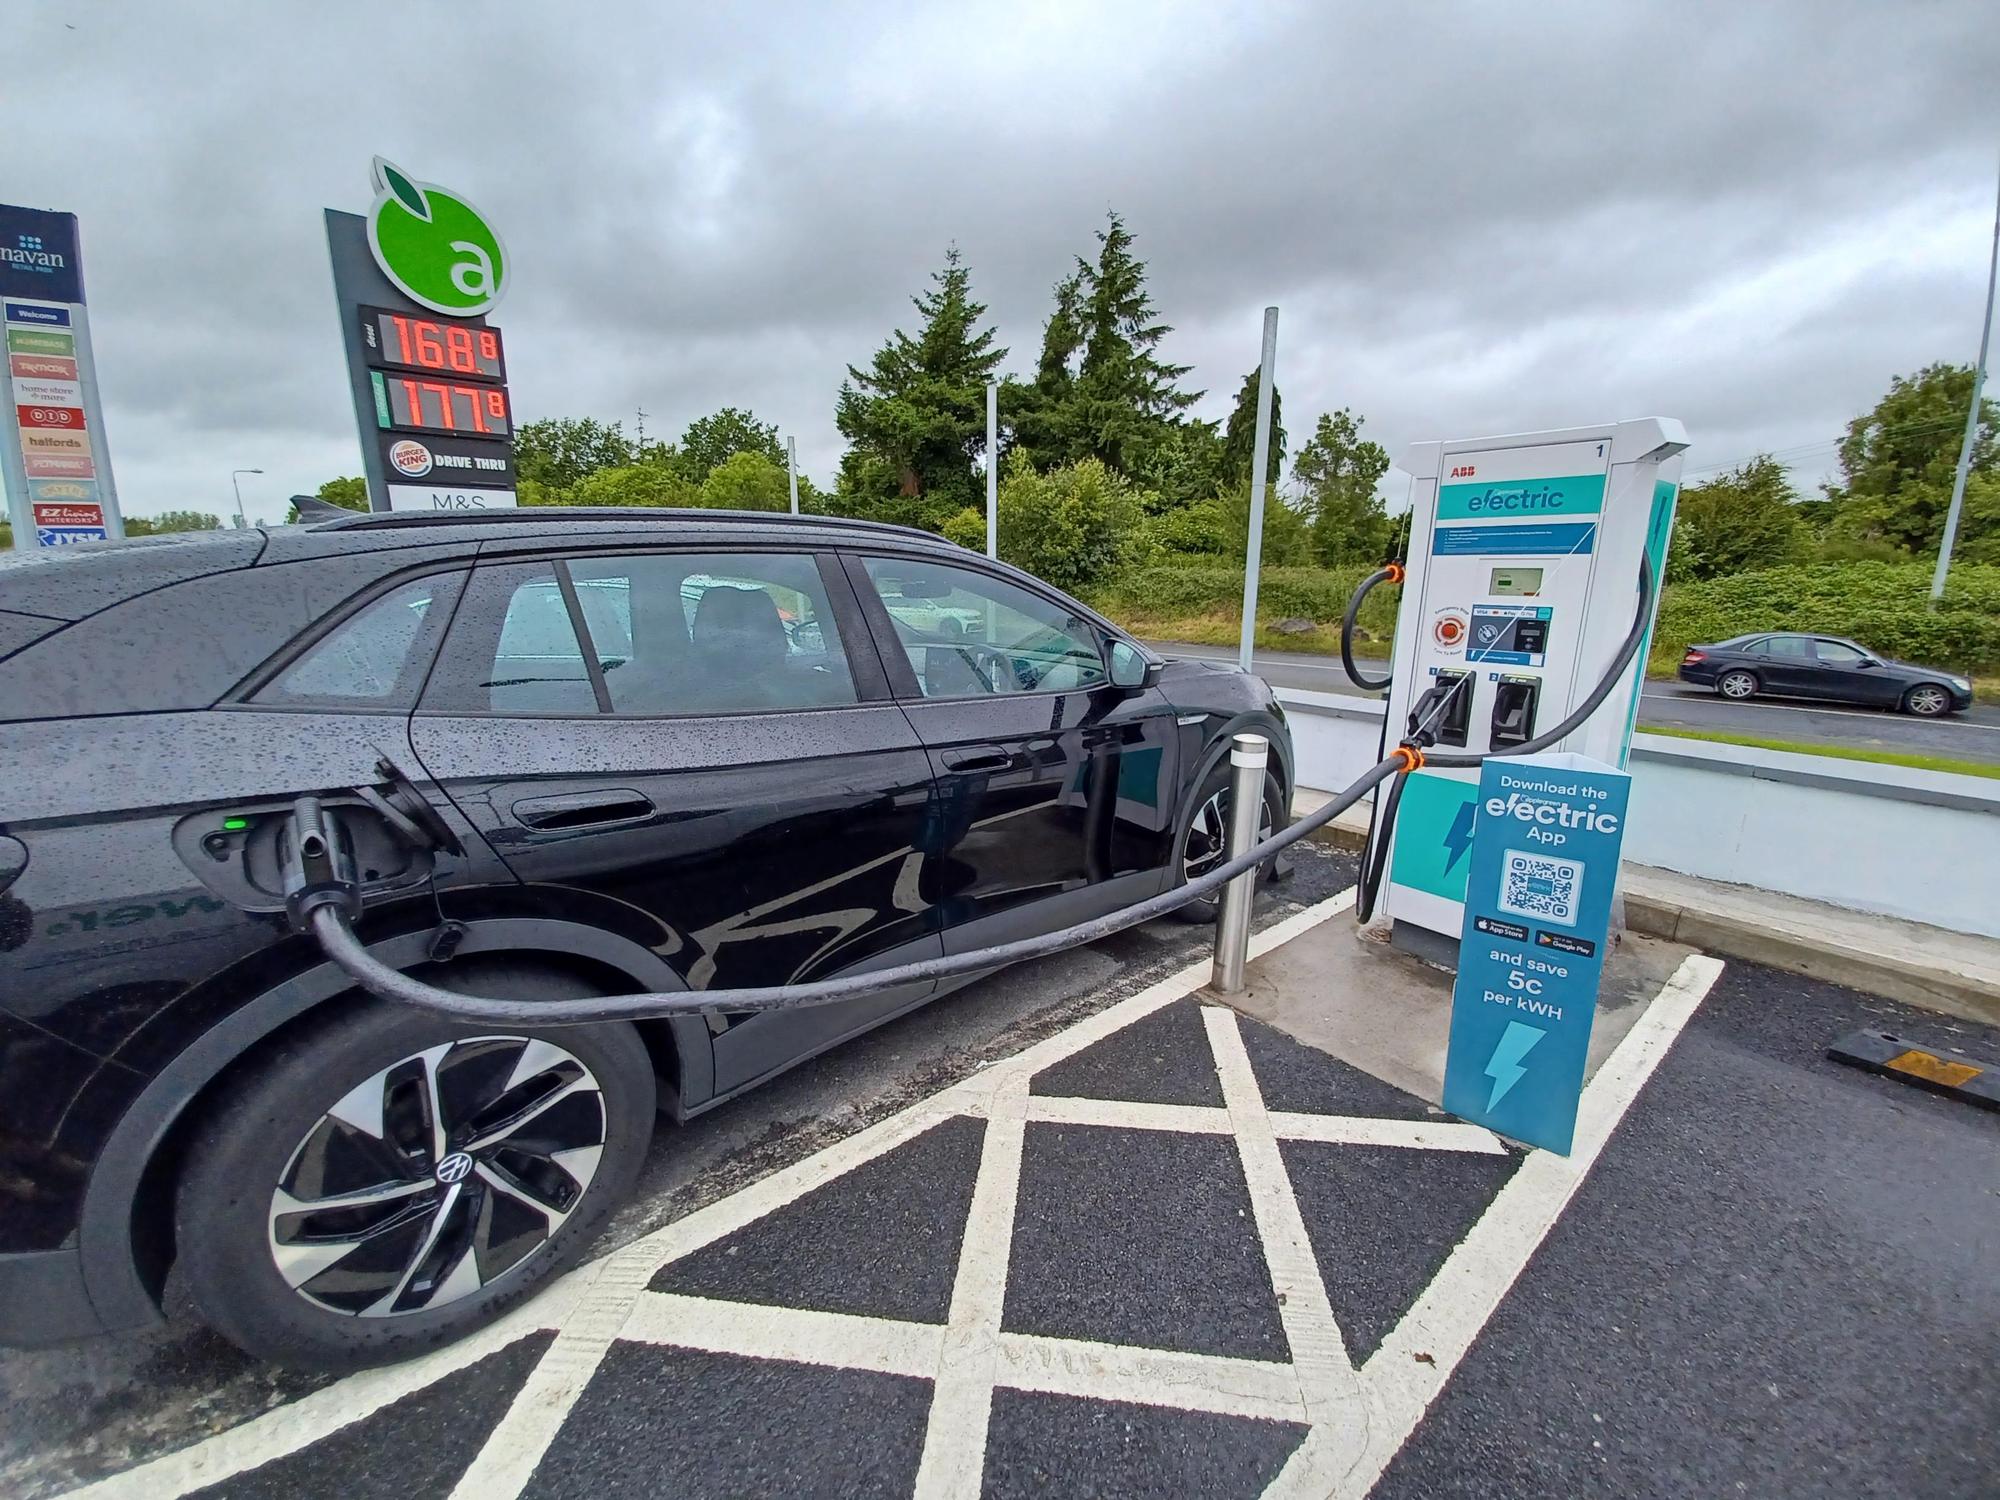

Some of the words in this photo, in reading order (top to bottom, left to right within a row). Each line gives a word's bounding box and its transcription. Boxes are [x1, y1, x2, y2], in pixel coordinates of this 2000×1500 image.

[0, 247, 65, 268] navan
[18, 310, 58, 321] Welcome
[21, 383, 48, 394] home
[49, 387, 74, 396] store
[41, 394, 66, 402] more
[29, 437, 81, 448] halfords
[395, 448, 425, 459] BURGER
[1596, 444, 1604, 458] 1
[398, 454, 428, 467] KING
[434, 454, 472, 469] DRIVE
[473, 457, 507, 471] THRU
[1450, 465, 1476, 478] ABB
[432, 493, 486, 510] M&S
[40, 508, 61, 517] EZ
[53, 533, 102, 545] JYSK
[1501, 775, 1577, 796] Download
[1581, 786, 1607, 800] the
[1526, 826, 1566, 846] App
[1489, 925, 1504, 935] App
[1504, 928, 1524, 939] Store
[1552, 940, 1576, 951] Google
[1576, 945, 1591, 955] Play
[1489, 950, 1522, 966] and
[1527, 959, 1568, 978] save
[1483, 990, 1512, 1006] per
[1517, 997, 1562, 1020] kWH
